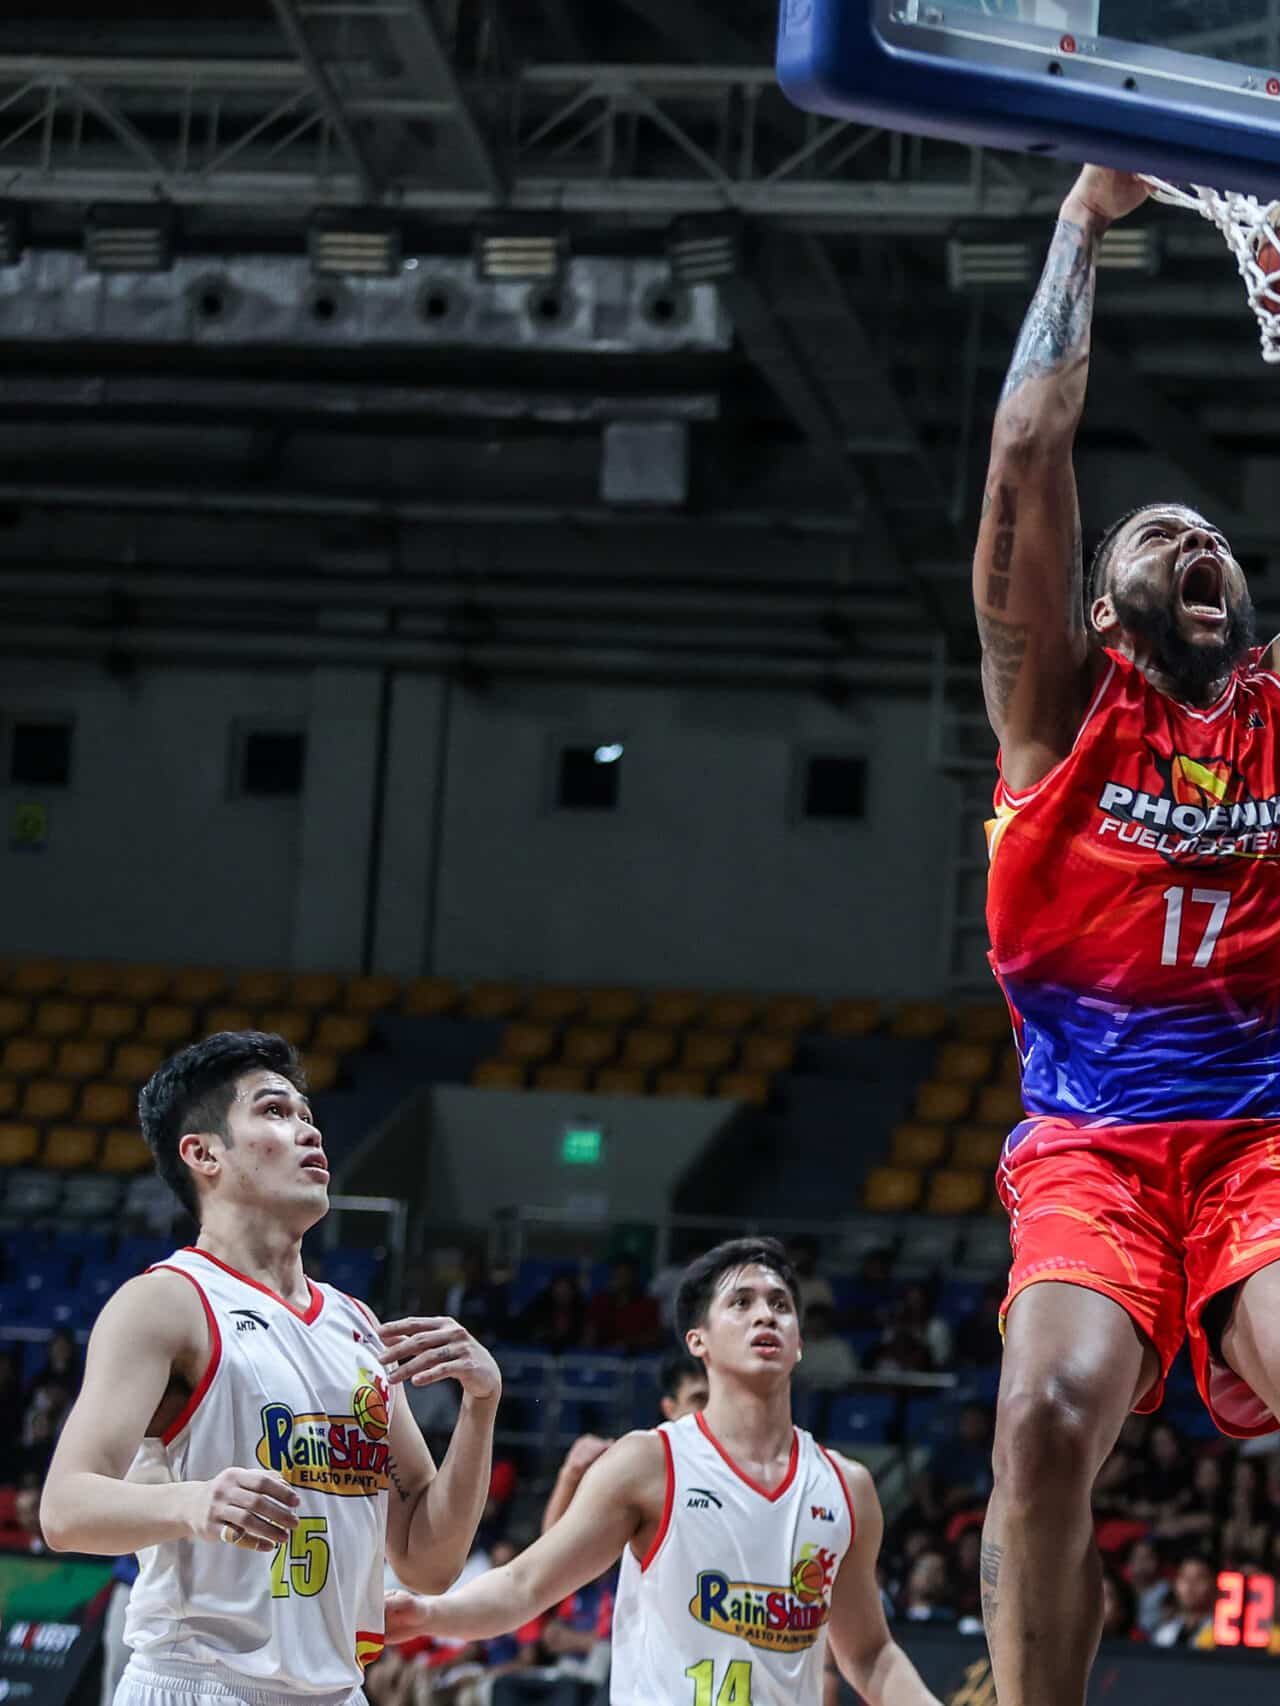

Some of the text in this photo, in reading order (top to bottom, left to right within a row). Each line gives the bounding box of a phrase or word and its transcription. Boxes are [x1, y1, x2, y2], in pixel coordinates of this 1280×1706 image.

[1160, 885, 1232, 968] 17
[1214, 1571, 1275, 1648] 22
[684, 1658, 753, 1706] 14
